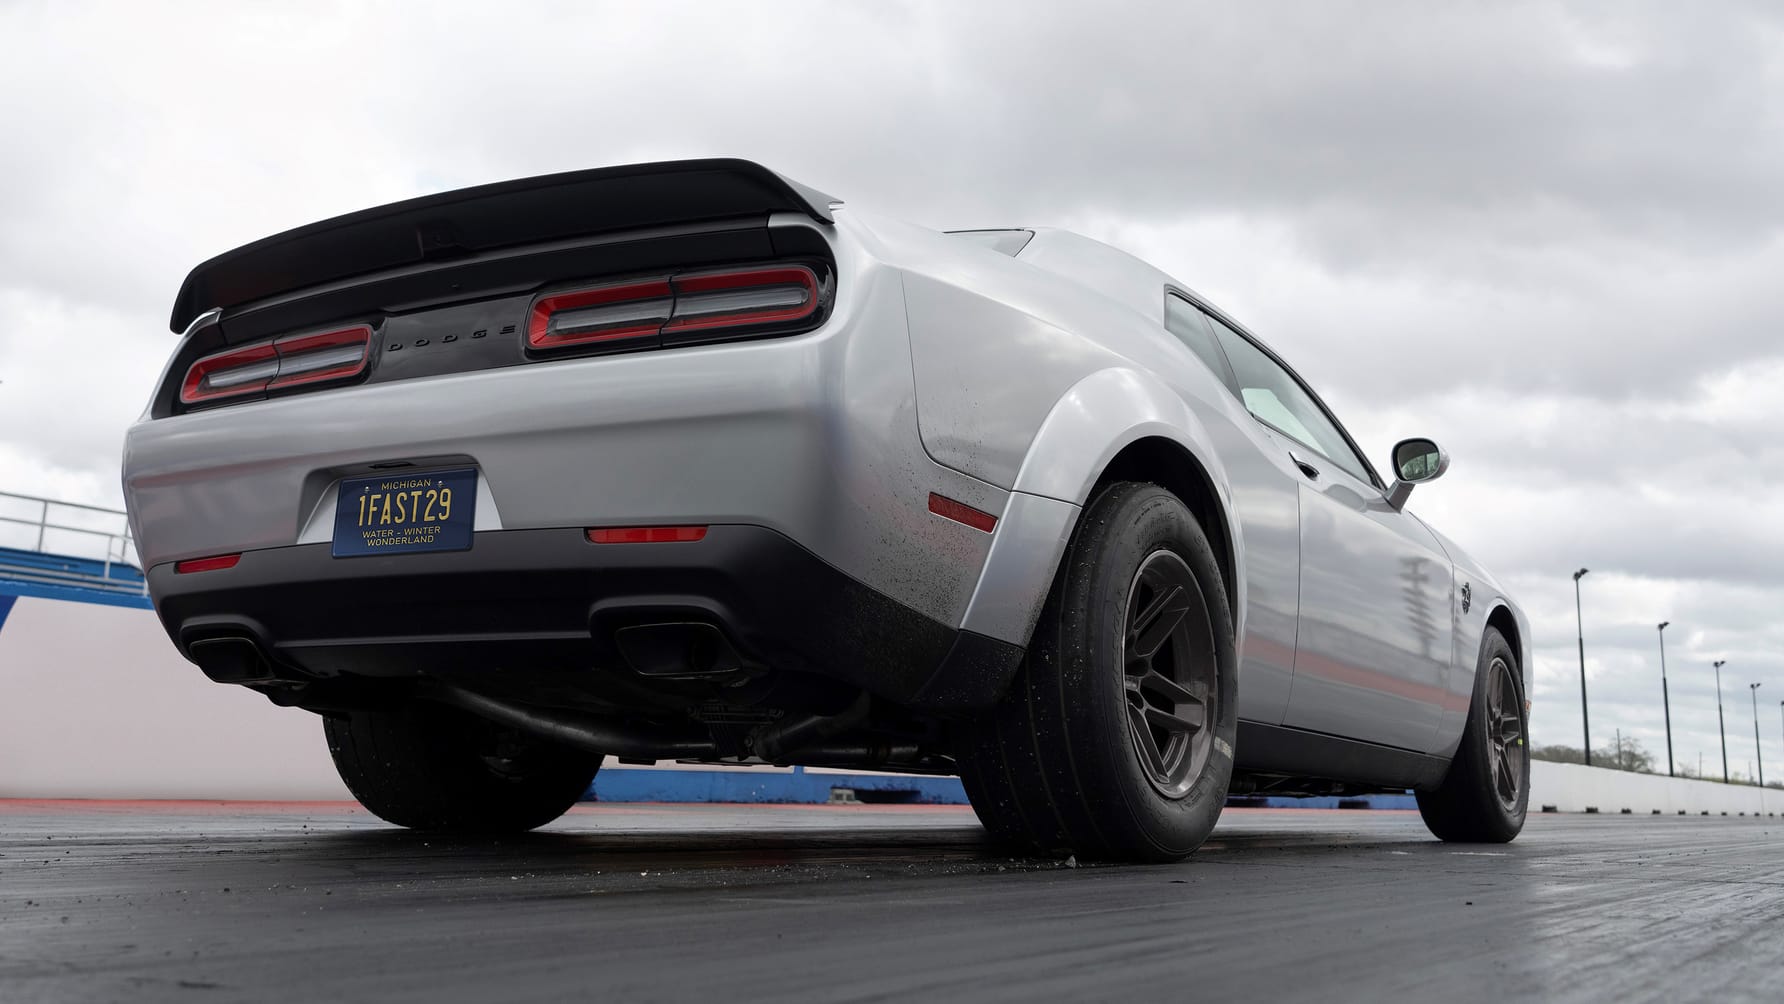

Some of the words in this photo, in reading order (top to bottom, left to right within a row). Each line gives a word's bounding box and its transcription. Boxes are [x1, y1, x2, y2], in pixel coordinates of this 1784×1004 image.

[388, 325, 516, 352] DODGE
[381, 479, 432, 491] MICHIGAN
[358, 488, 452, 527] 1FAST29
[362, 529, 394, 539] WATER
[403, 526, 441, 536] WINTER
[367, 536, 434, 546] WONDERLAND
